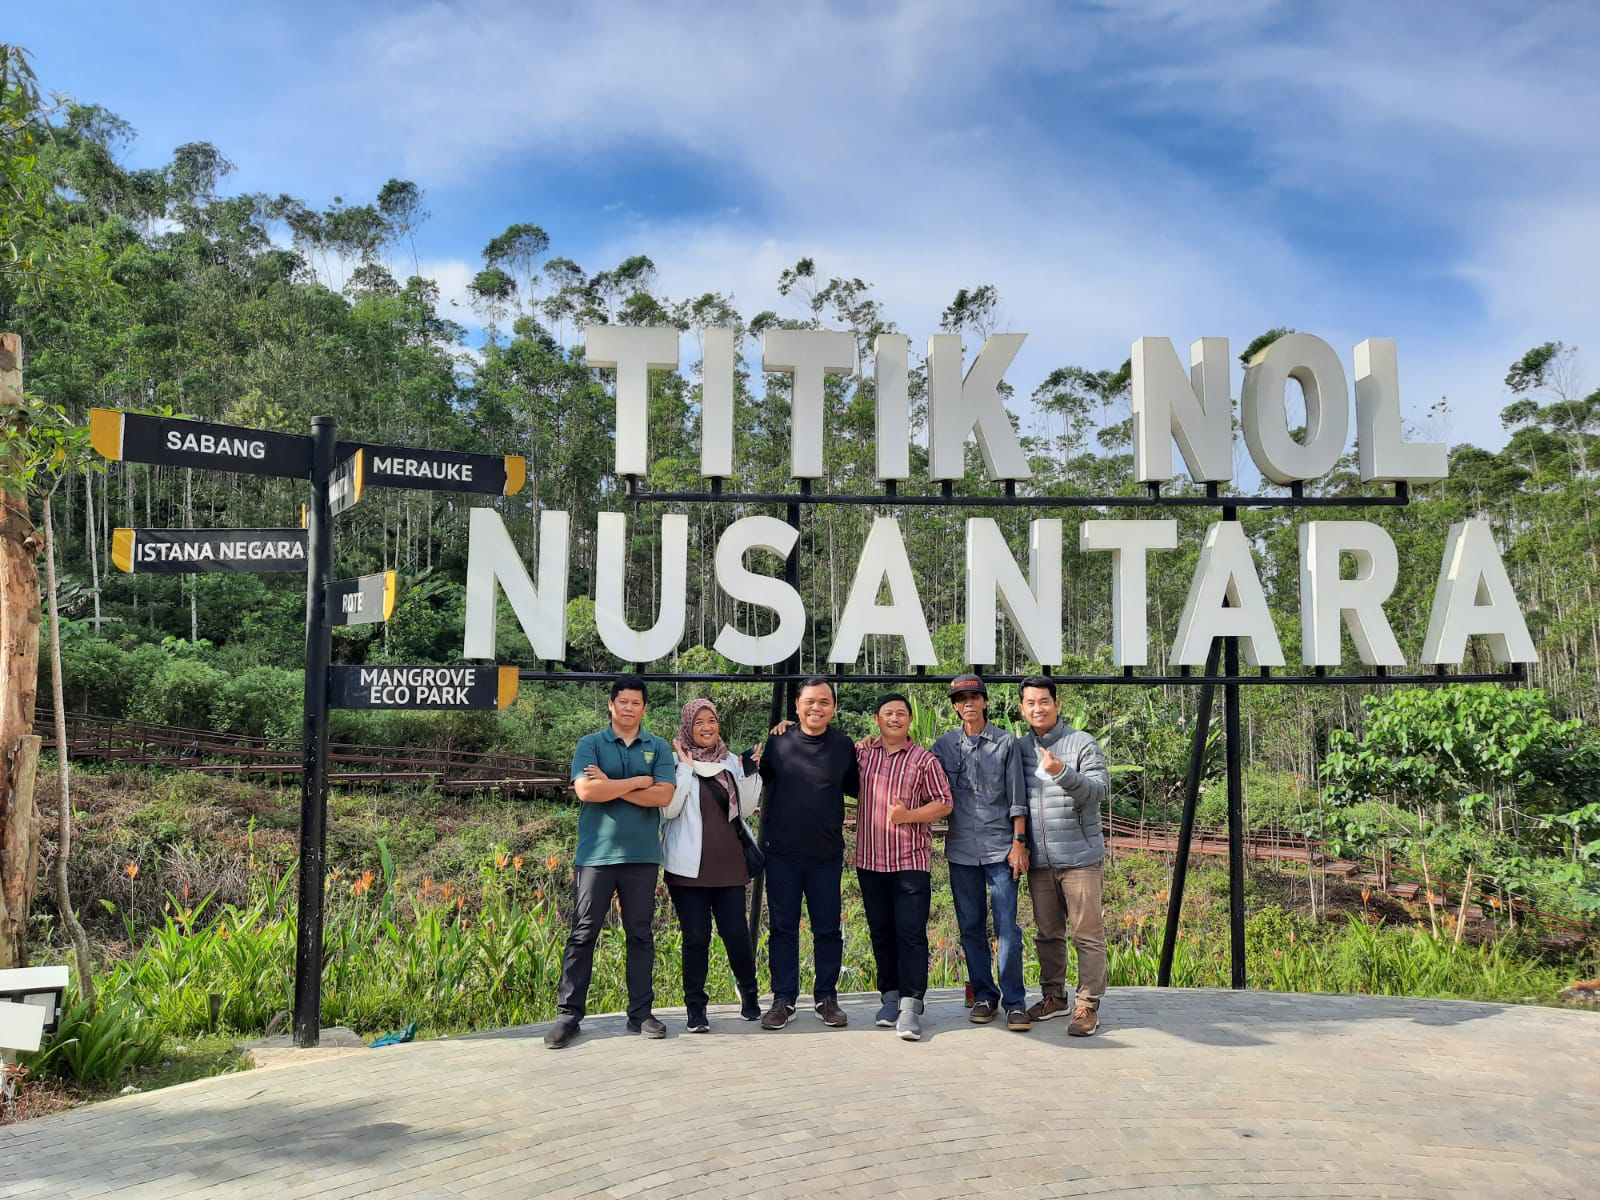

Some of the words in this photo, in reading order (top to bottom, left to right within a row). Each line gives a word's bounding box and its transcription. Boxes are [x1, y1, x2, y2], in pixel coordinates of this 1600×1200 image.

[585, 325, 1033, 482] TITIK
[1131, 333, 1449, 486] NOL
[166, 430, 266, 459] SABANG
[372, 456, 473, 482] MERAUKE
[137, 542, 215, 562] ISTANA
[219, 541, 304, 560] NEGARA
[463, 507, 1539, 667] NUSANTARA
[342, 592, 365, 613] ROTE
[360, 668, 476, 687] MANGROVE
[370, 686, 410, 704] ECO
[416, 687, 470, 705] PARK
